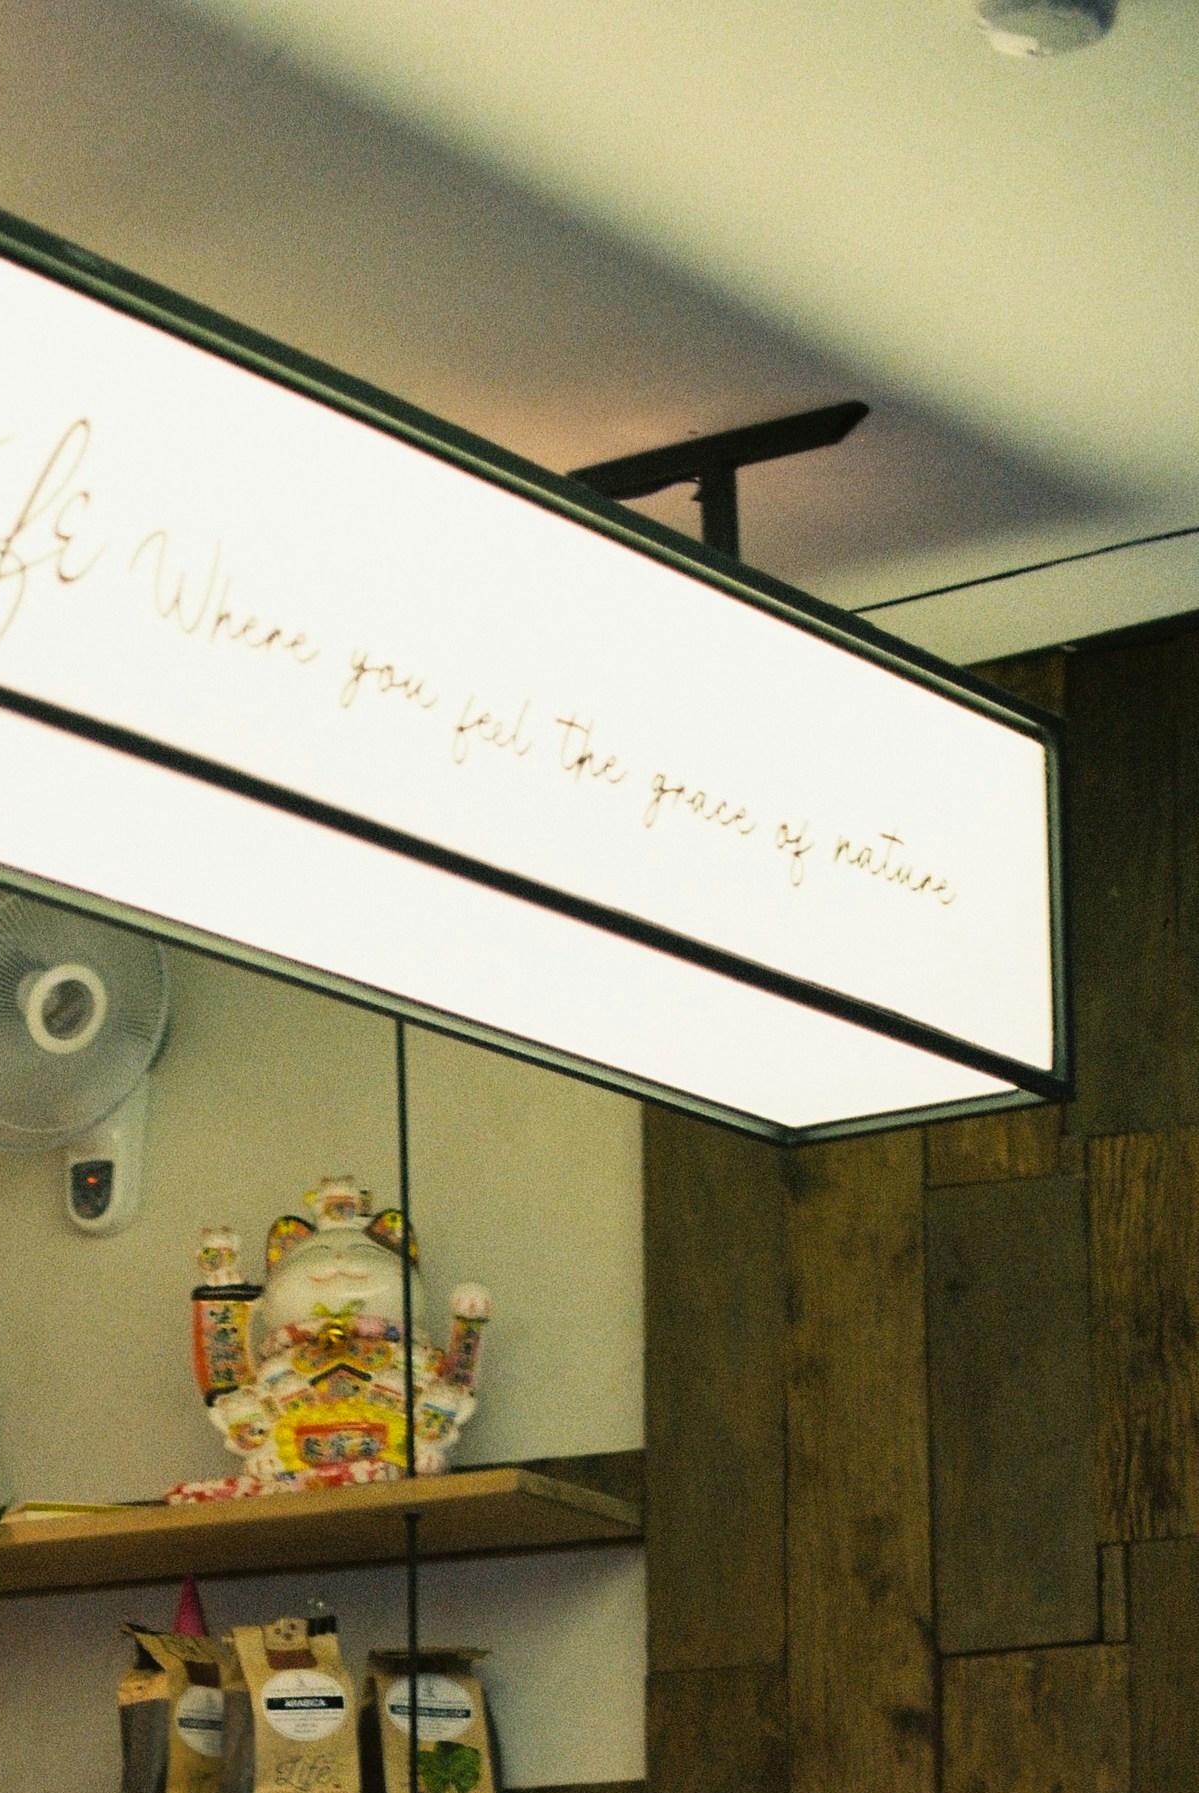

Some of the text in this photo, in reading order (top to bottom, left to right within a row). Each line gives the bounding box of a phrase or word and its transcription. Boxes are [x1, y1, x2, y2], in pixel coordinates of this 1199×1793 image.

[129, 529, 956, 906] Where you feel the grace of nature
